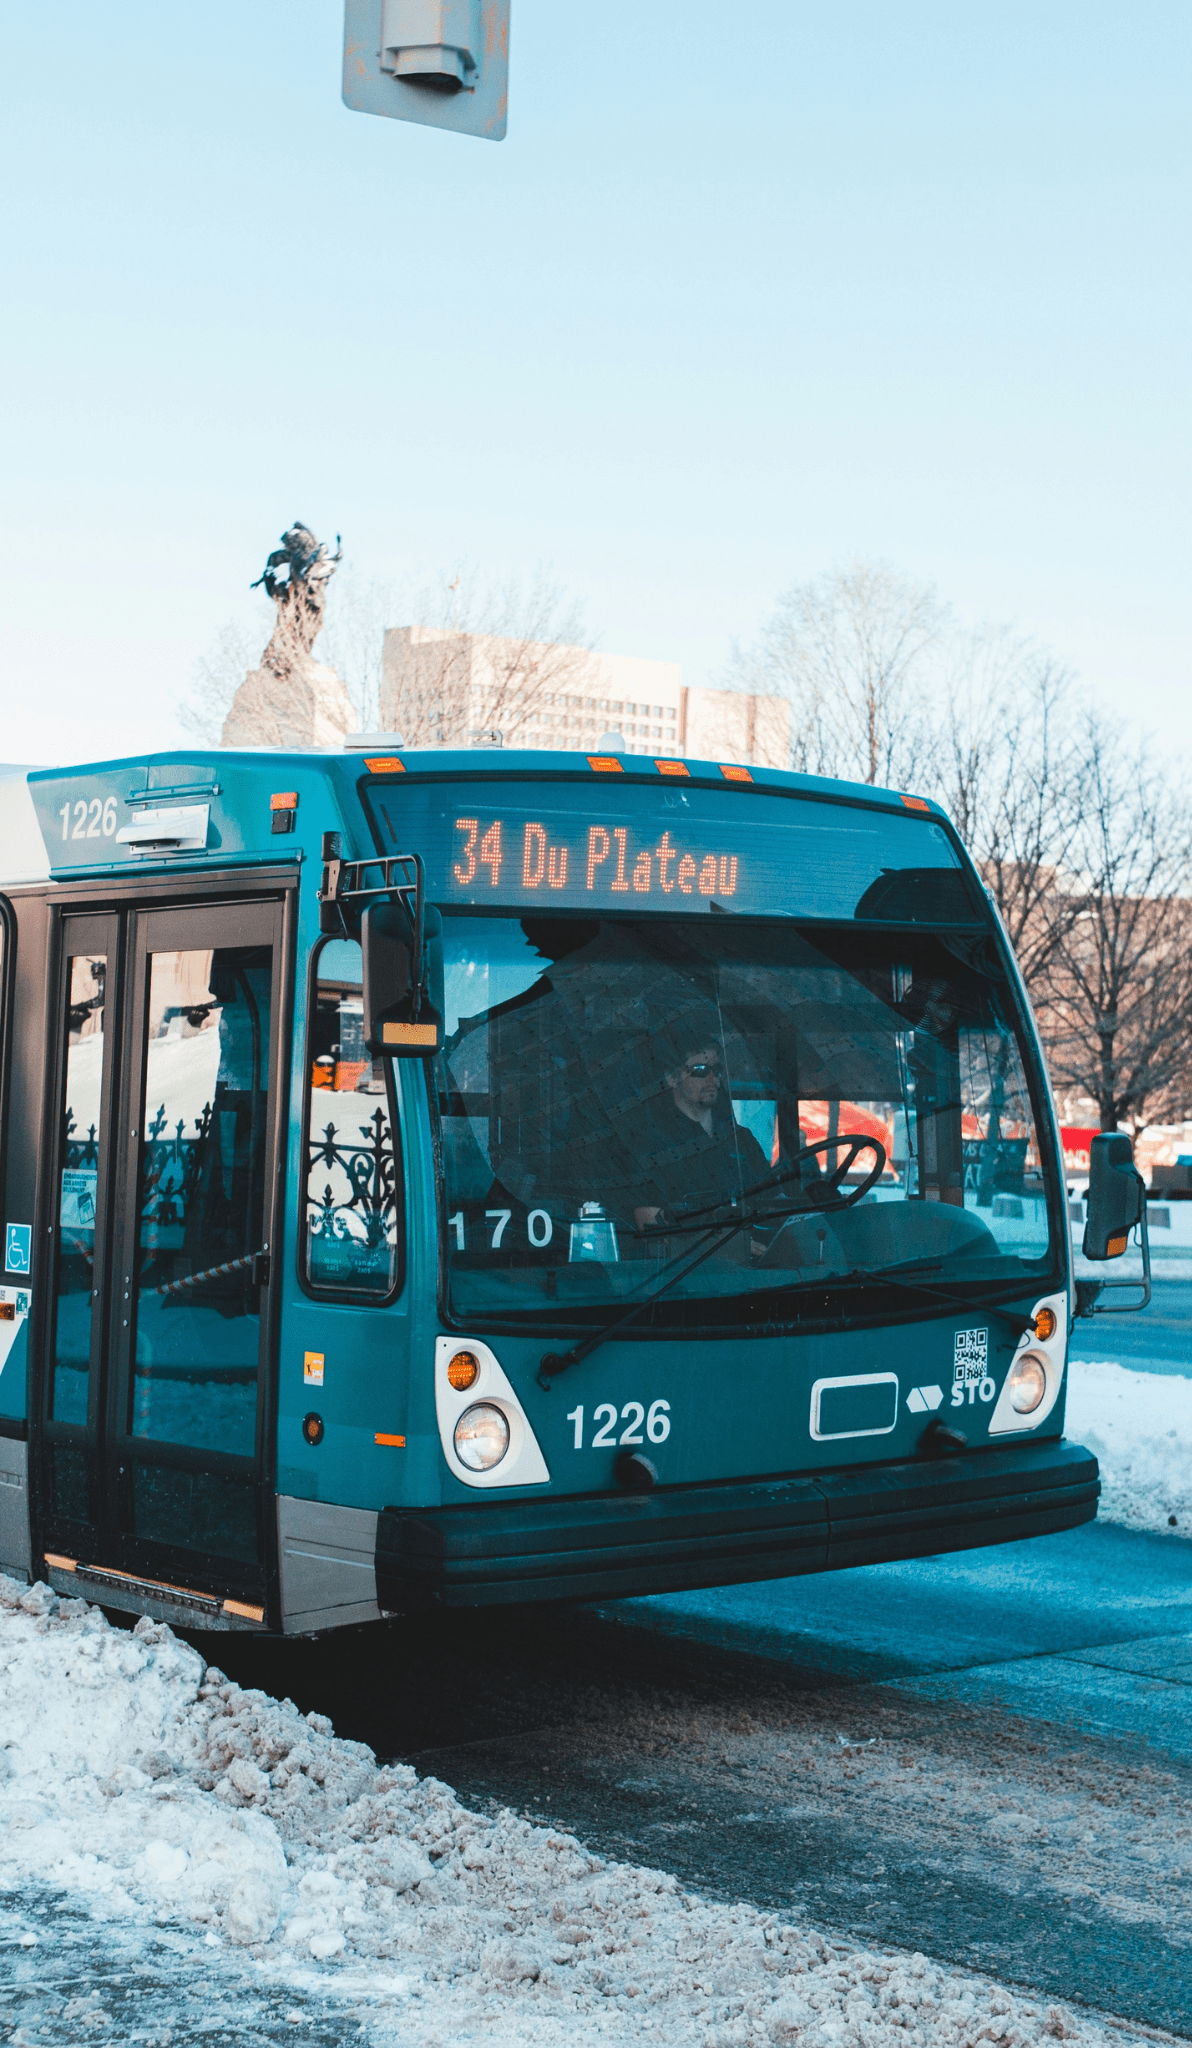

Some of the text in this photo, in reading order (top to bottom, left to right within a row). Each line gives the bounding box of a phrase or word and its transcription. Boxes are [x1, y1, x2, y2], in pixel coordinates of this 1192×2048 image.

[59, 796, 118, 841] 1226
[453, 818, 739, 896] 34 Du Plateau
[950, 1376, 996, 1407] STO
[566, 1398, 672, 1450] 1226
